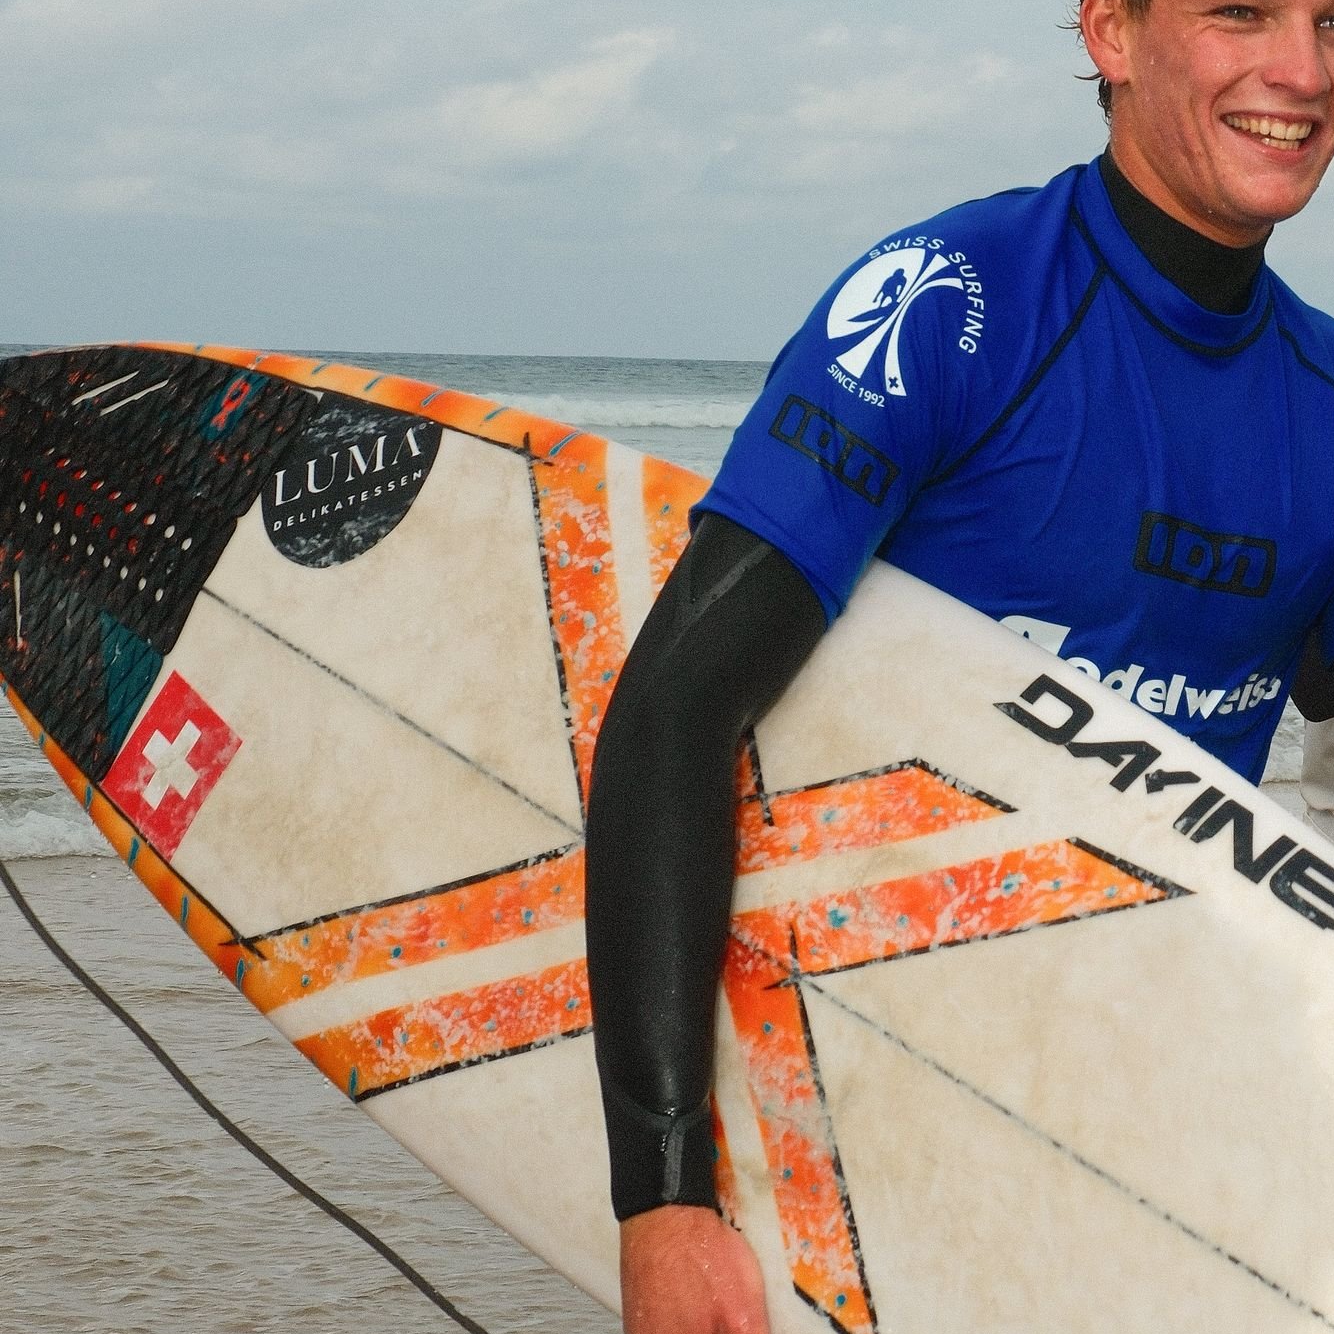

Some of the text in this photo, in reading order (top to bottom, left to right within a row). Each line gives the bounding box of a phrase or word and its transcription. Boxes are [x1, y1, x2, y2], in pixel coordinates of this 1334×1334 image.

[869, 236, 985, 355] SWISS SURFING
[827, 363, 885, 407] SINCE 1992
[273, 469, 422, 532] DELIKATESSEN
[274, 427, 422, 507] LUMA
